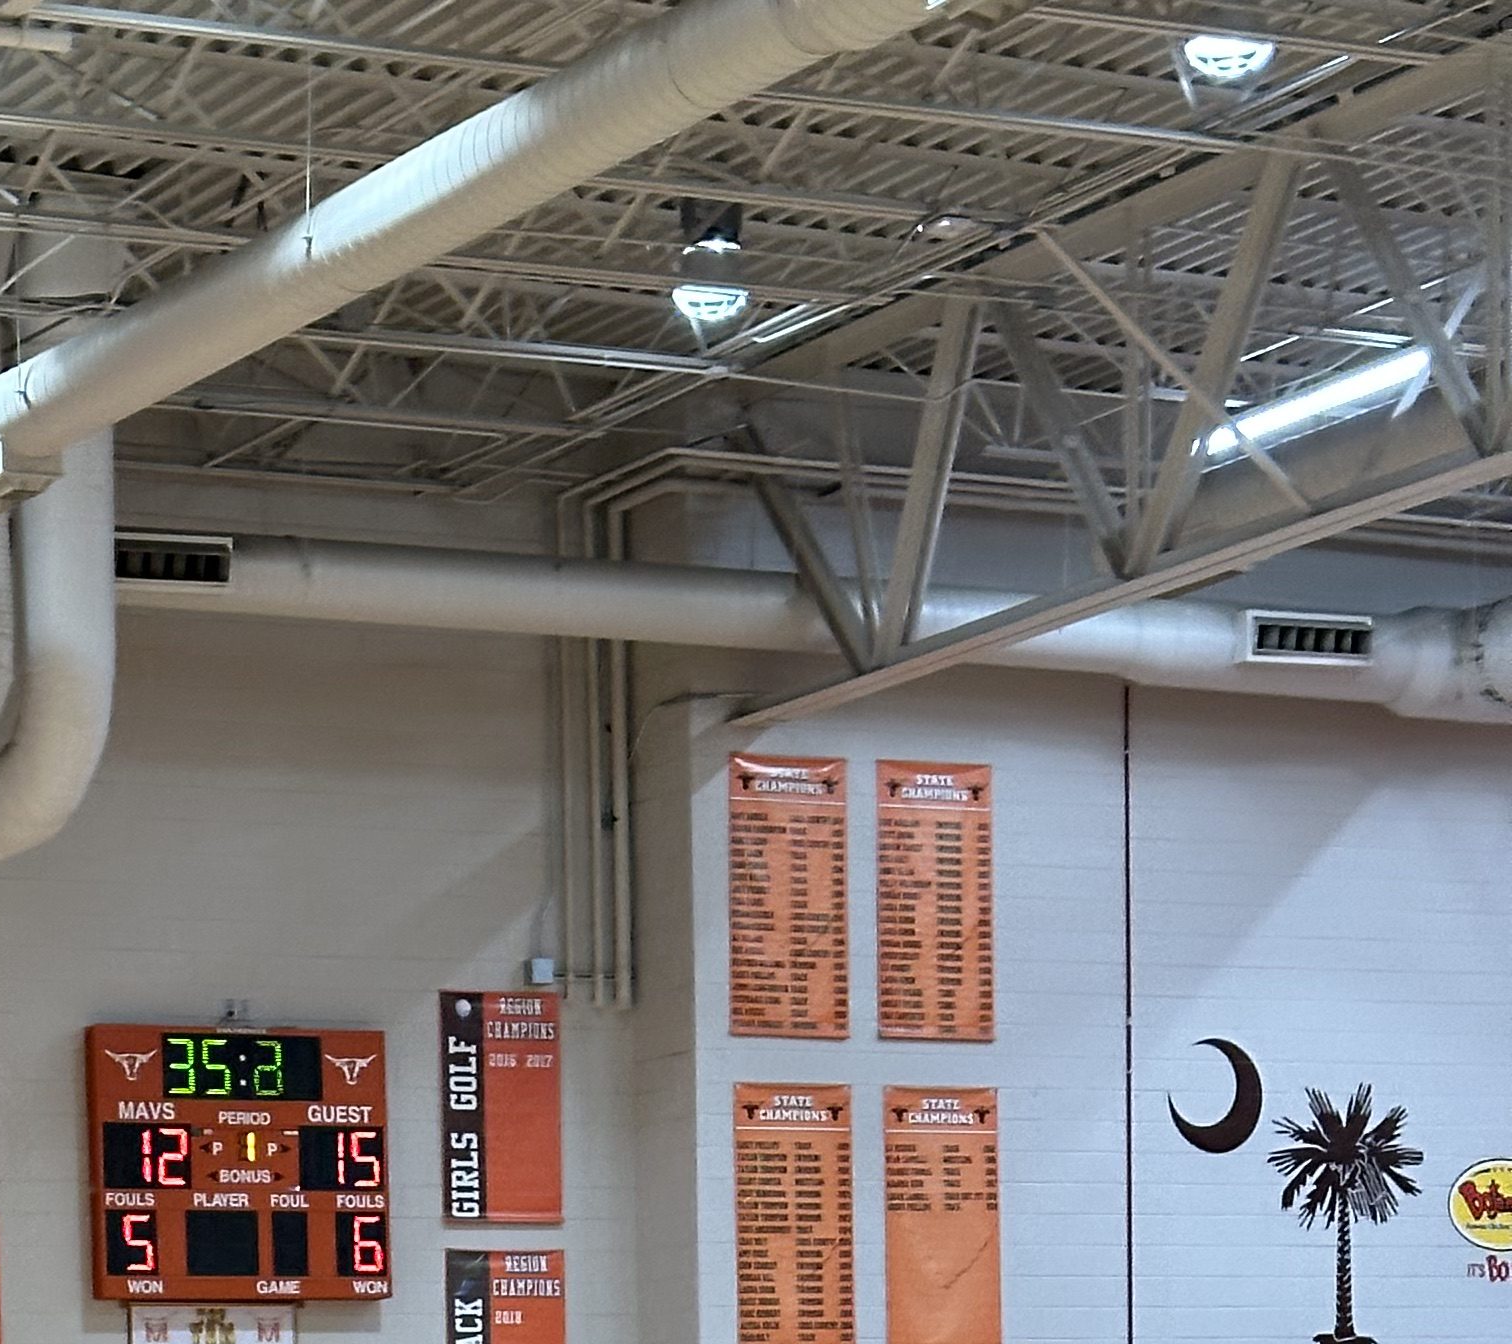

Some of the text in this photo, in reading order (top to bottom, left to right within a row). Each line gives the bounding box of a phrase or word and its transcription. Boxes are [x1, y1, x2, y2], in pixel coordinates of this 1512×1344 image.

[916, 774, 954, 786] STATE
[901, 787, 968, 801] CHAMPIONS
[487, 1021, 555, 1039] CHAMPIONS
[774, 1095, 812, 1107] STATE
[922, 1099, 960, 1110] STATE
[119, 1102, 175, 1120] MAVS
[219, 1111, 271, 1125] PERIOD
[307, 1105, 372, 1123] GUEST
[759, 1109, 827, 1121] CHAMPIONS
[909, 1113, 974, 1124] CHAMPIONS
[448, 1036, 480, 1218] GIRLS GOLF
[213, 1142, 223, 1155] P
[246, 1132, 256, 1162] 1
[267, 1143, 278, 1156] P
[141, 1128, 188, 1186] 12
[337, 1131, 380, 1187] 15
[220, 1170, 271, 1183] BONUS
[105, 1193, 155, 1206] FOULS
[194, 1193, 309, 1208] PLAYER FOUL
[337, 1195, 384, 1208] FOULS
[122, 1214, 155, 1271] 5
[353, 1216, 384, 1272] 6
[505, 1256, 548, 1272] REGION
[128, 1281, 163, 1294] WON
[257, 1281, 300, 1294] GAME
[353, 1281, 388, 1294] WON
[493, 1279, 560, 1296] CHAMPIONS
